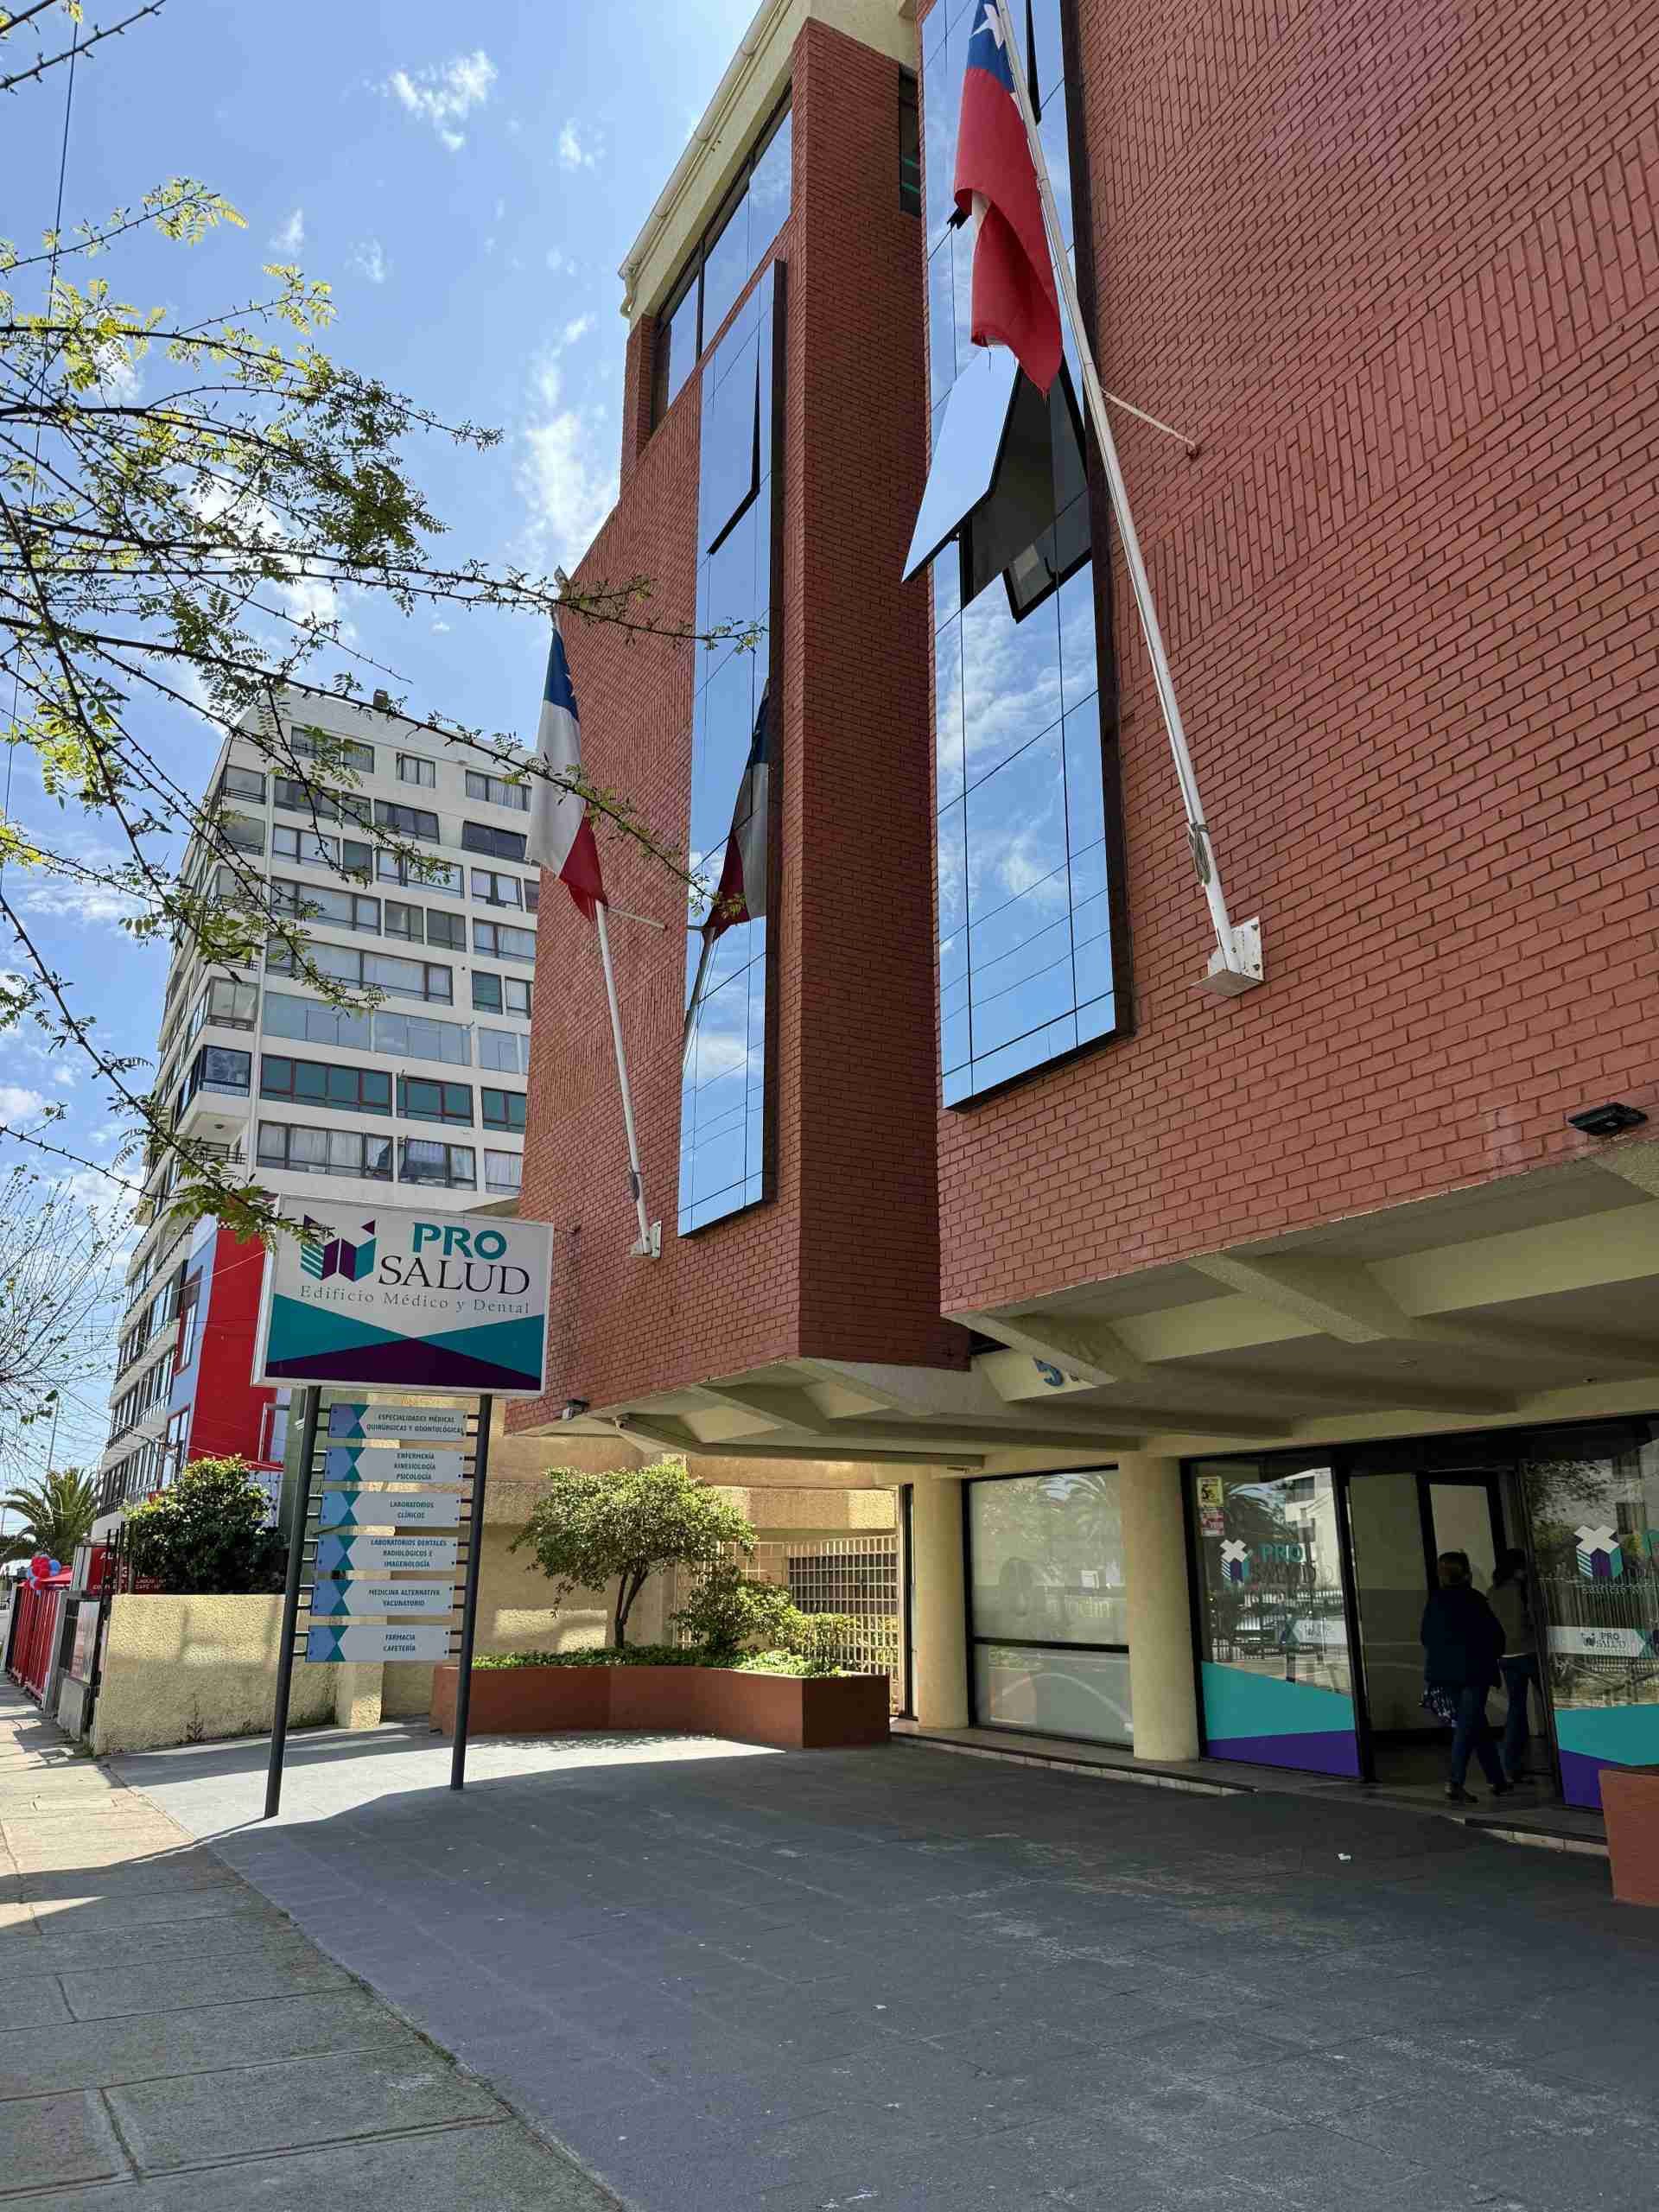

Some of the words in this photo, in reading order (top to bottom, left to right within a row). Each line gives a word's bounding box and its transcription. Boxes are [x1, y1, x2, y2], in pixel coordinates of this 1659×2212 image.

[412, 1222, 507, 1260] PRO
[378, 1255, 530, 1295] SALUD
[299, 1285, 375, 1304] Edificio
[384, 1291, 448, 1309] Médico
[455, 1300, 466, 1313] y
[474, 1299, 530, 1314] Dental
[429, 1414, 454, 1423] MÉDICAS
[397, 1510, 425, 1519] CLÍNICOS
[1600, 1631, 1619, 1640] PRO
